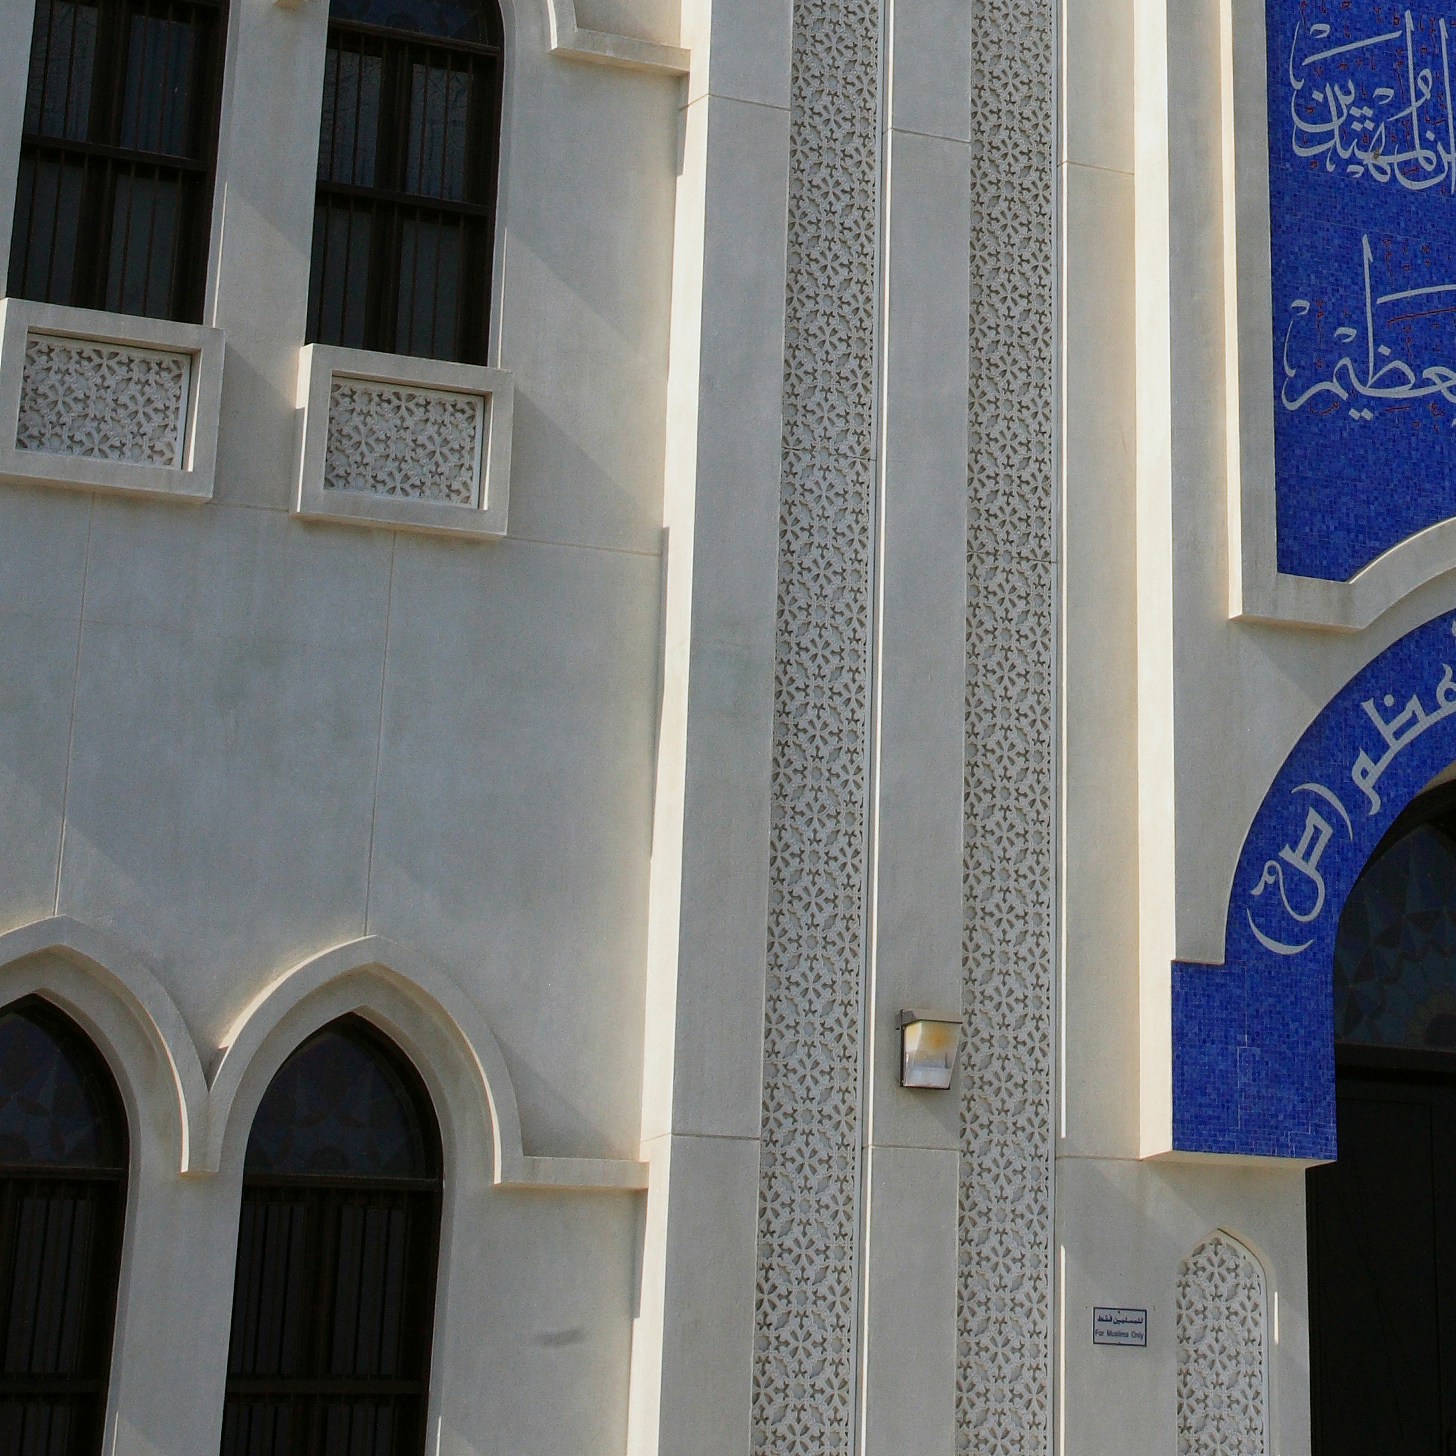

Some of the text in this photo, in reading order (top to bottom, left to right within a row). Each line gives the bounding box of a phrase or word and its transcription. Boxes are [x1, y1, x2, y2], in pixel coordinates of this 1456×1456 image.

[1097, 1313, 1113, 1323] فقط
[1106, 1329, 1129, 1338] Muslims
[1130, 1330, 1144, 1341] Only
